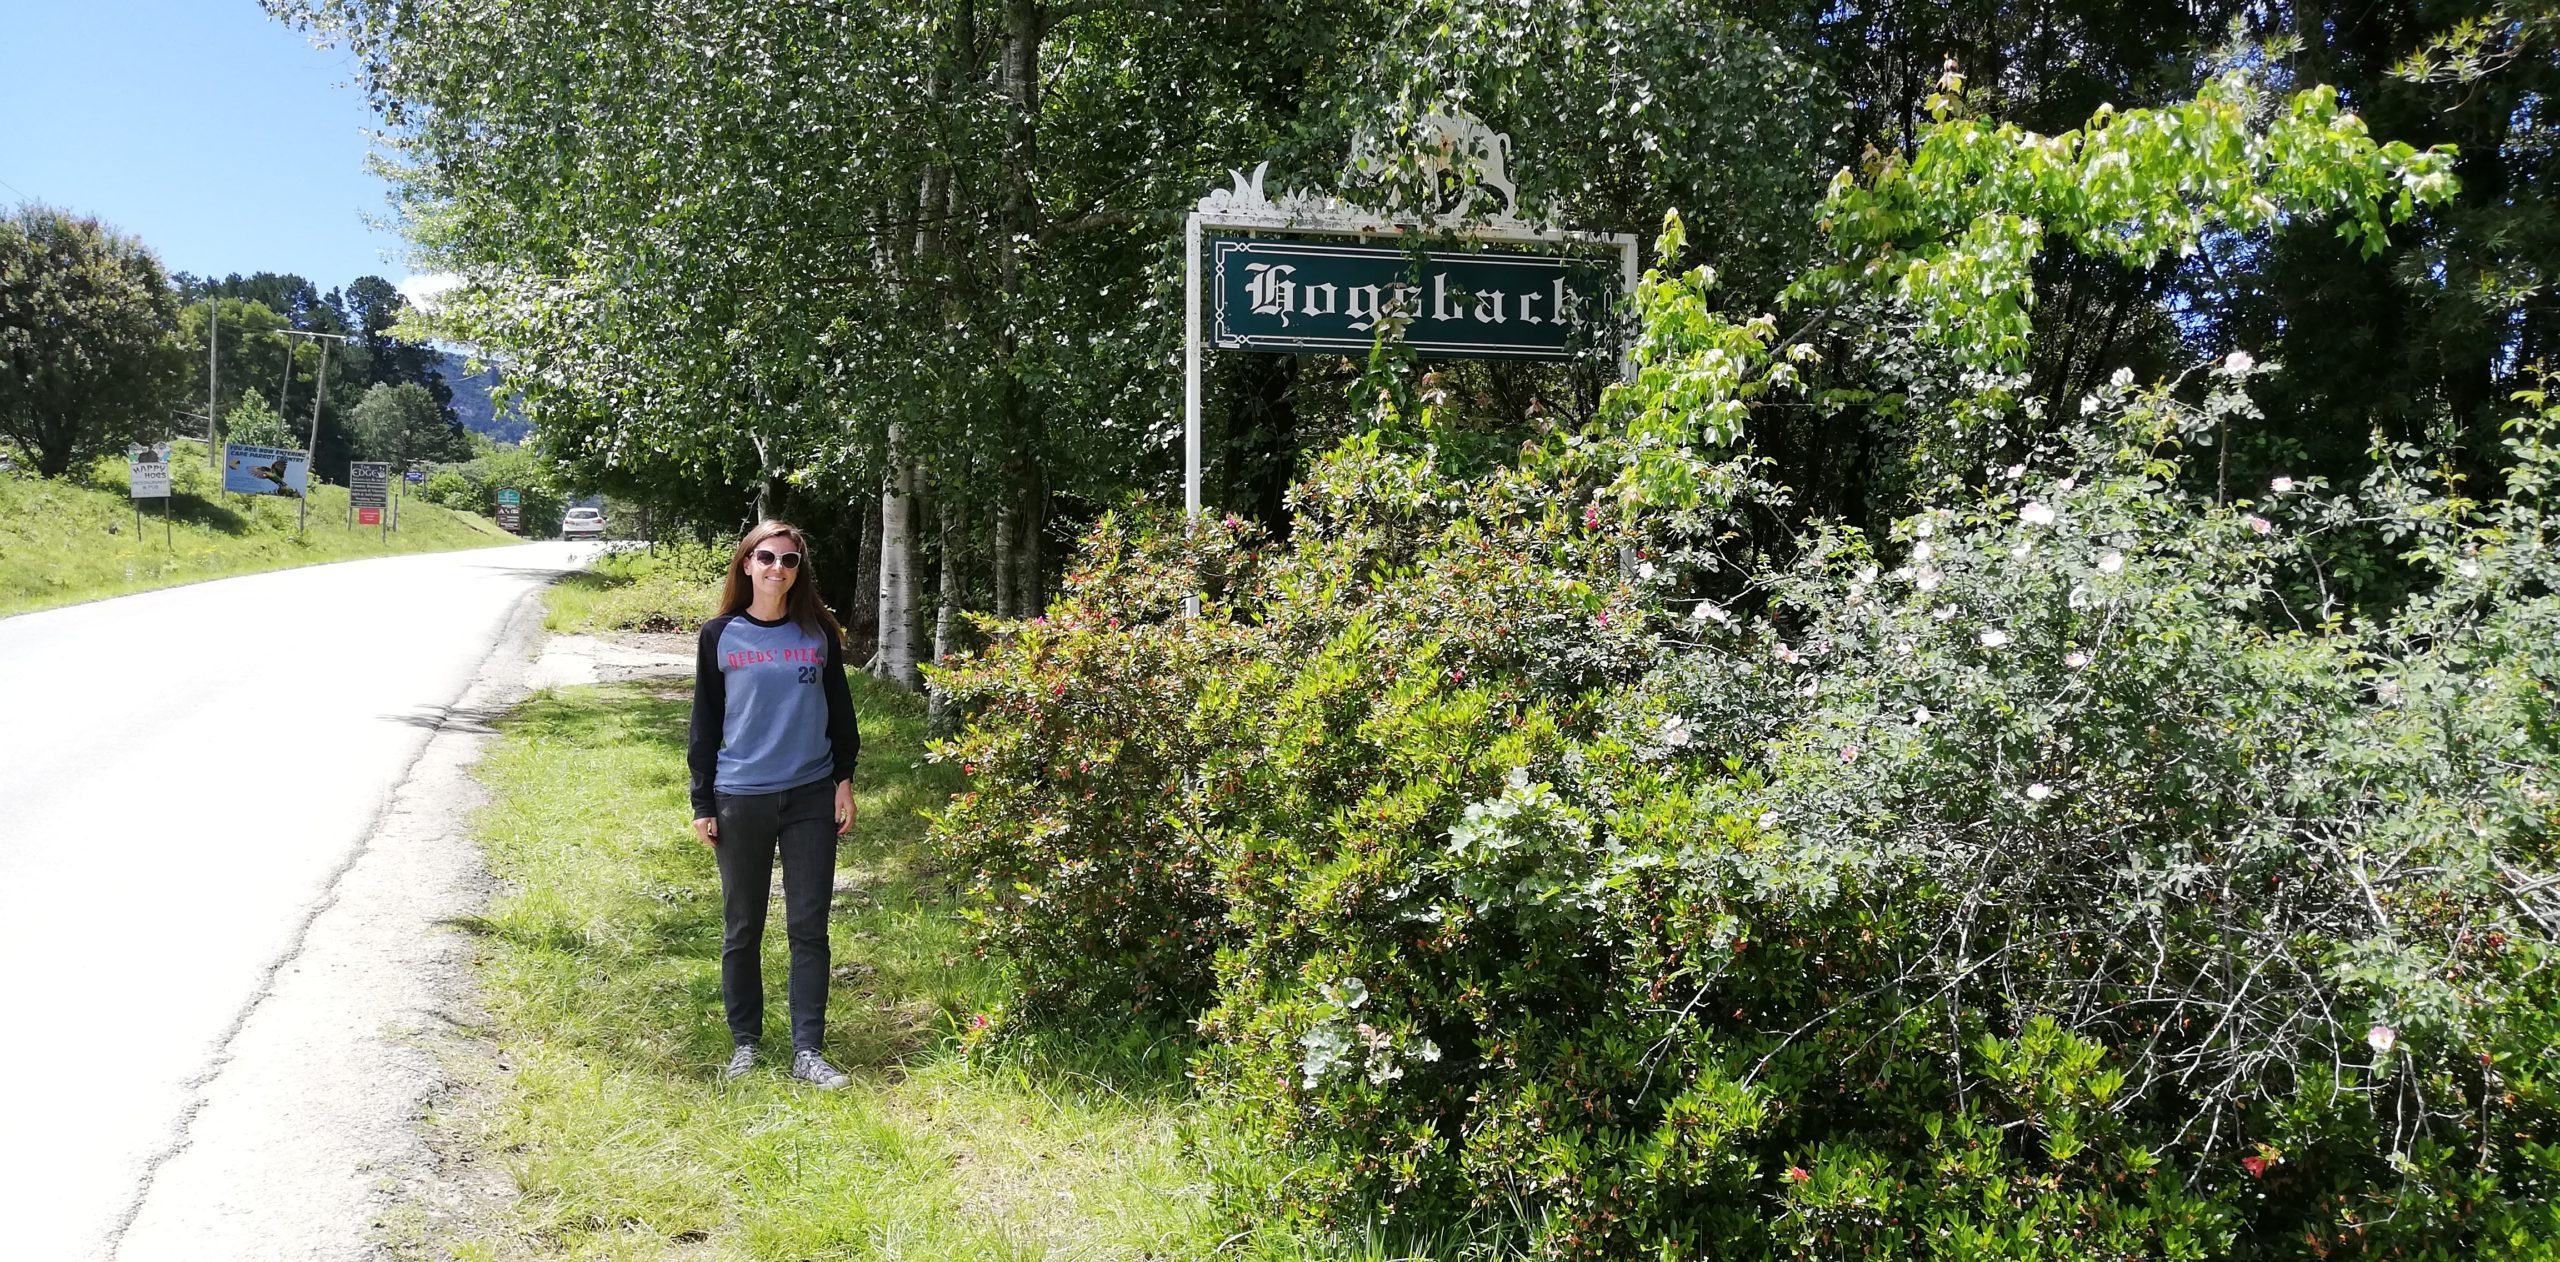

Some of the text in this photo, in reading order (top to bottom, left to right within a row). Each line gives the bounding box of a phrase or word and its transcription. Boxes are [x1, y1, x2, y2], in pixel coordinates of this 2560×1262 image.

[1244, 262, 1586, 331] Hogsback
[249, 452, 275, 460] PARROT
[276, 455, 305, 463] COUNTRY
[276, 449, 306, 458] ENTERING
[133, 465, 166, 475] HAPPY
[352, 468, 379, 478] EDGE
[798, 665, 817, 685] 23
